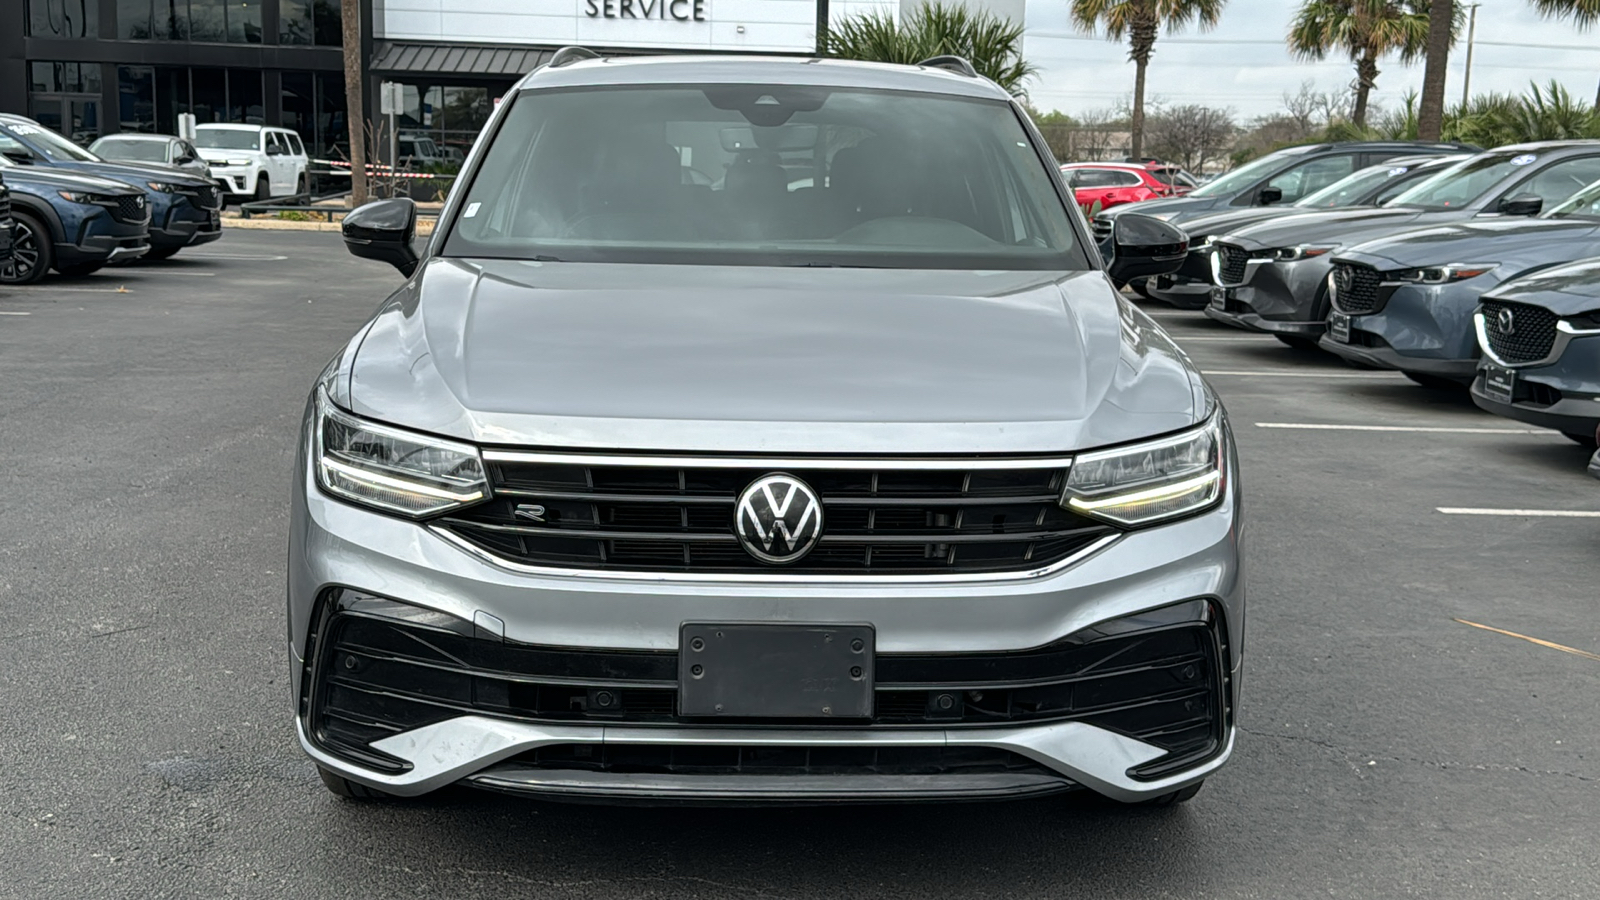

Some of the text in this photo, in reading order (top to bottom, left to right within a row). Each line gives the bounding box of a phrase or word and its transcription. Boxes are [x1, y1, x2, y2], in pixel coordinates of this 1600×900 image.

[585, 0, 705, 21] SERVICE
[514, 503, 546, 522] R
[738, 476, 820, 559] VW
